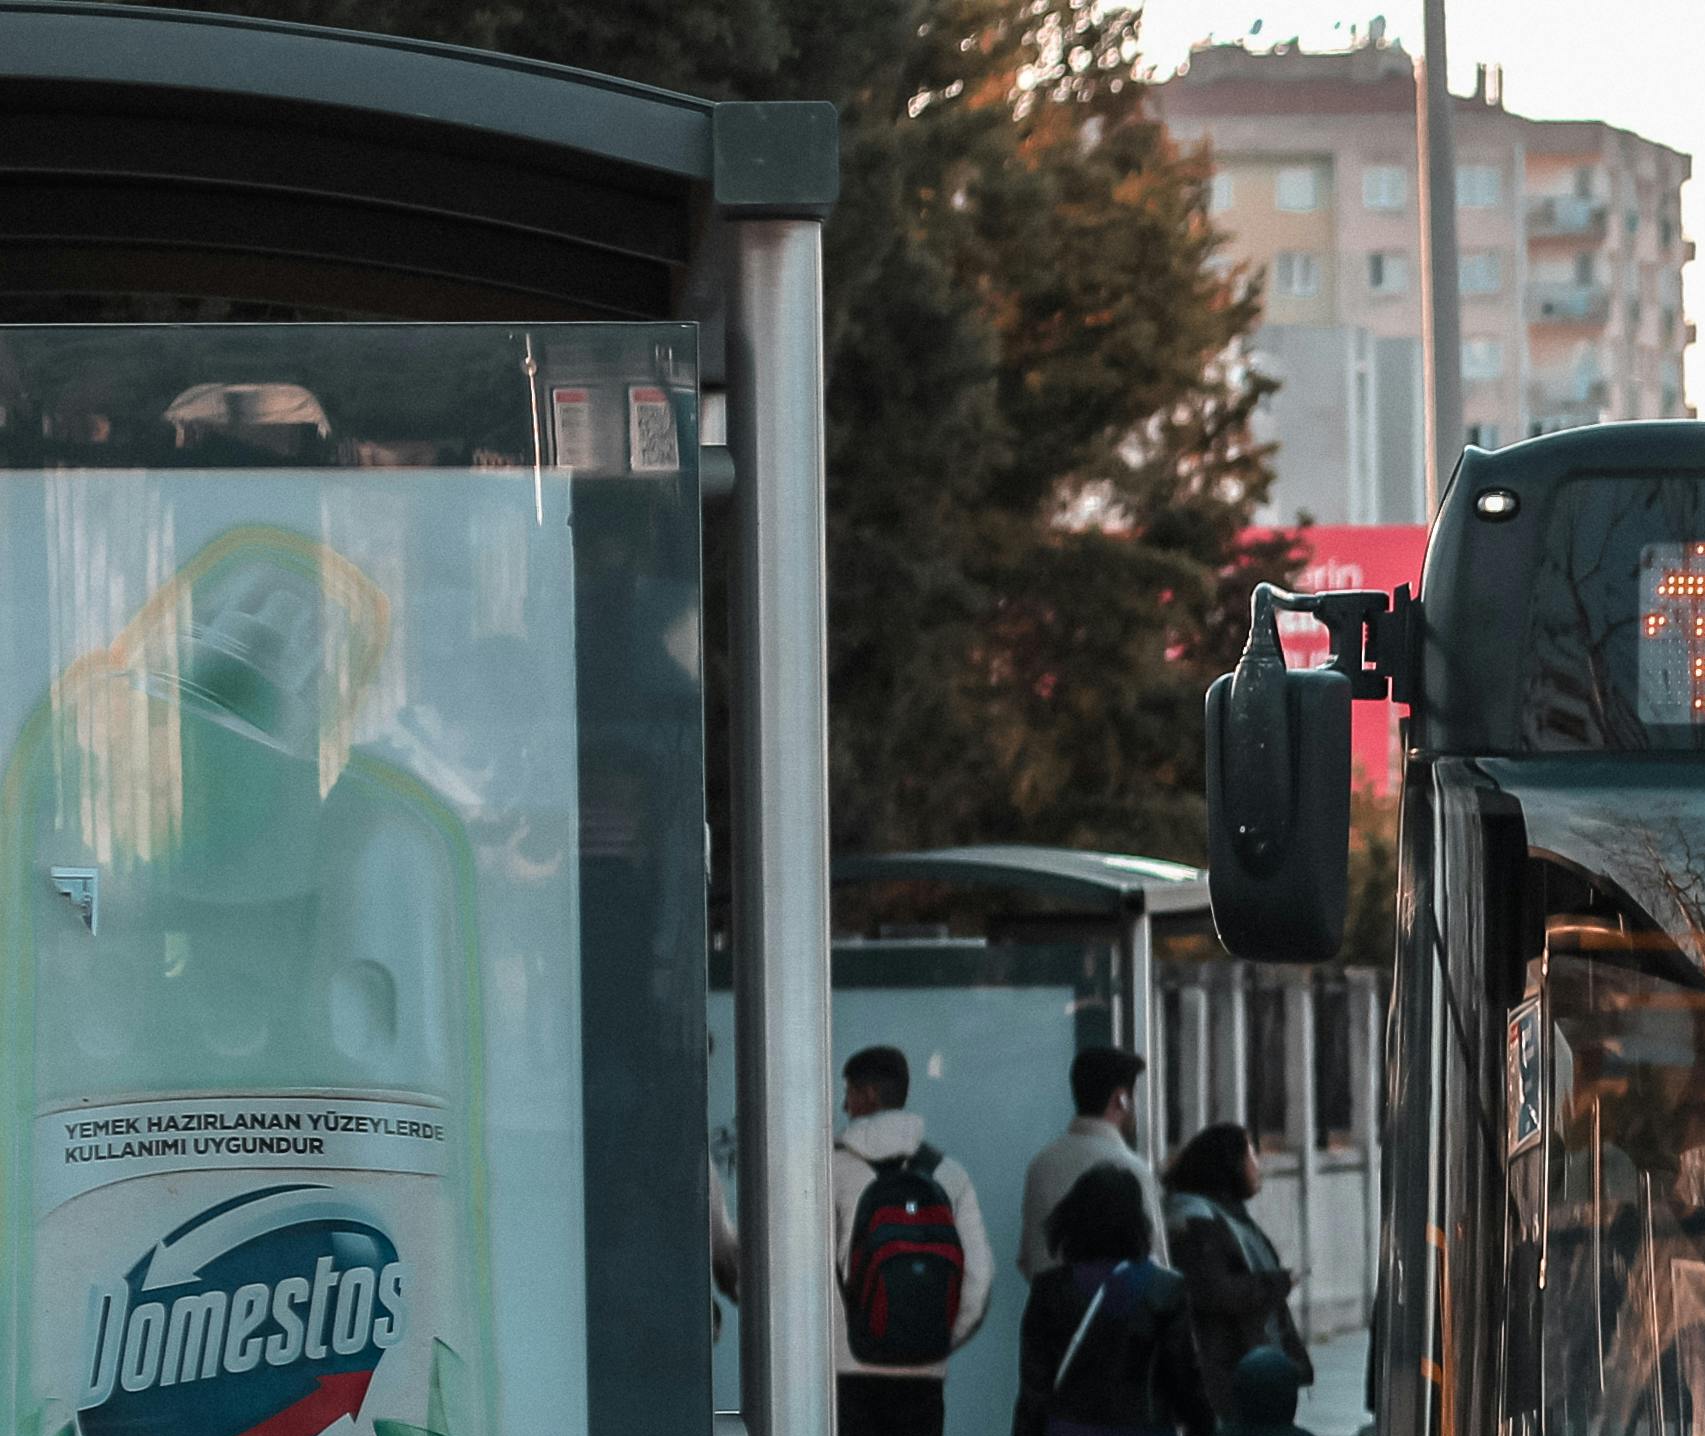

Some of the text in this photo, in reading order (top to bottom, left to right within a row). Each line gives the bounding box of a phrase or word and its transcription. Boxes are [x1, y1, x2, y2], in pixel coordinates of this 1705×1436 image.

[65, 1110, 444, 1142] YEMEK HAZIRLANAN YÜZEYLERDE
[64, 1136, 324, 1164] KULLANIMI UYGUNDUR
[80, 1255, 405, 1398] Domestos
